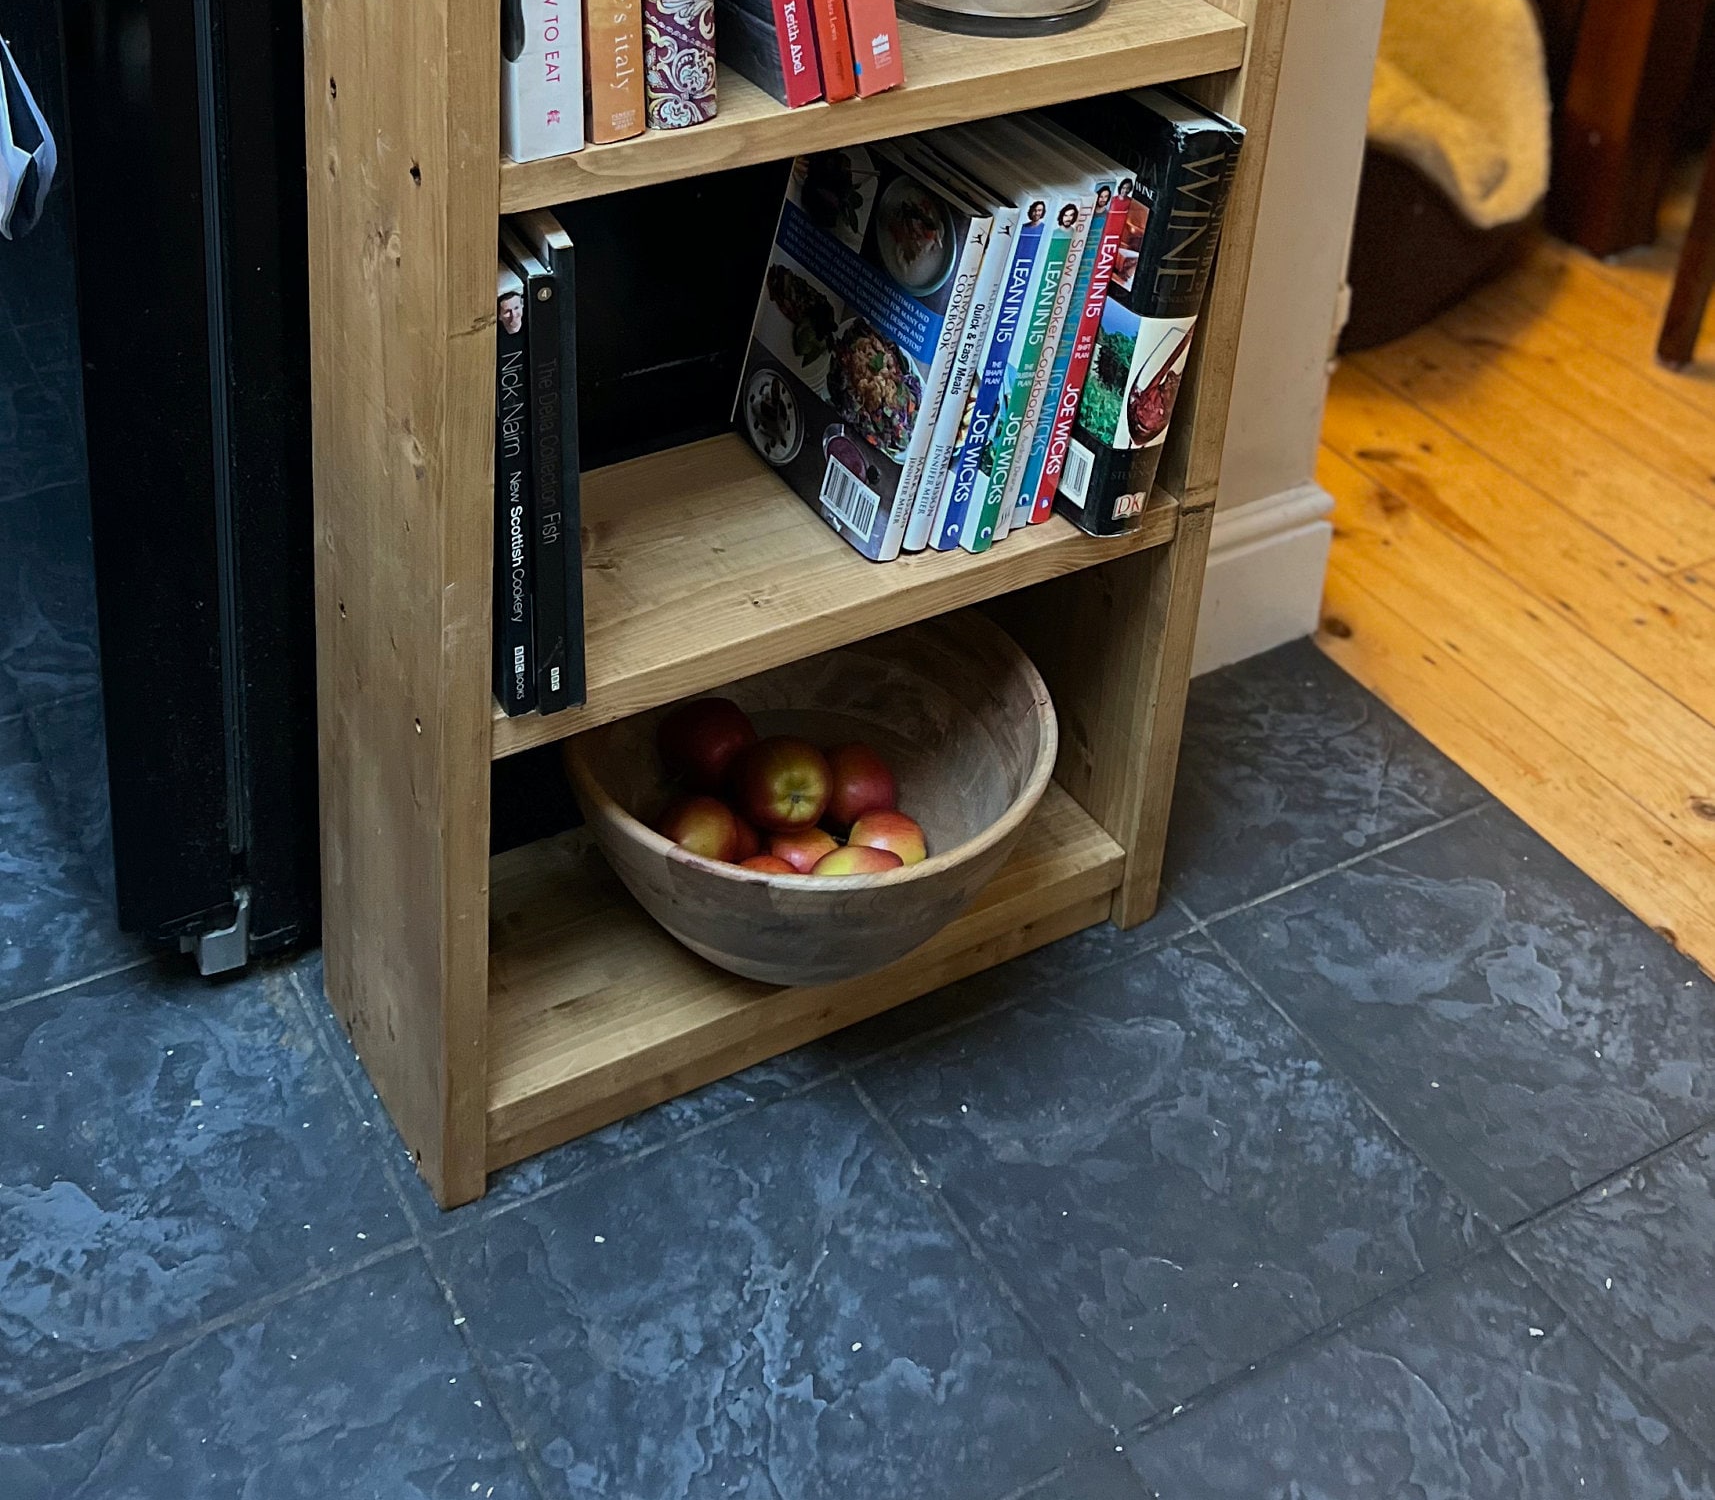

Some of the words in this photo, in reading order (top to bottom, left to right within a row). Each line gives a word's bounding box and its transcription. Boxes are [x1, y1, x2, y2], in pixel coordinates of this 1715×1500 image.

[543, 15, 560, 42] TO
[783, 0, 800, 42] Keith
[544, 50, 561, 83] EAT
[609, 32, 635, 92] italy
[790, 43, 805, 76] Abel
[1074, 204, 1093, 233] The
[1152, 150, 1226, 294] WINE
[1063, 239, 1084, 277] Slow
[1094, 234, 1120, 280] LEAN
[1007, 258, 1032, 304] LEAN
[1041, 261, 1063, 306] LEAN
[1090, 281, 1107, 300] IN
[900, 310, 918, 327] MANY
[917, 322, 927, 333] OF
[915, 309, 930, 323] AND
[938, 273, 969, 352] COOKBOOK
[969, 303, 986, 331] Quick
[999, 306, 1019, 325] IN
[1032, 308, 1050, 330] IN
[1046, 282, 1072, 341] Cooker
[1085, 302, 1103, 319] 15
[889, 312, 911, 333] DESIGN
[909, 328, 925, 344] AND
[966, 333, 974, 341] &
[996, 327, 1013, 343] 15
[1029, 331, 1044, 346] 15
[958, 342, 975, 365] Easy
[501, 350, 524, 401] Nick
[537, 357, 558, 390] The
[950, 367, 967, 396] Meals
[1047, 366, 1064, 399] JOE
[538, 392, 559, 434] Delia
[1060, 382, 1080, 418] JOE
[502, 402, 525, 459] Nairn
[968, 409, 991, 445] JOE
[1001, 411, 1022, 447] JOE
[1029, 402, 1054, 457] WICKS
[1046, 419, 1074, 476] WICKS
[539, 434, 560, 510] Collection
[925, 444, 944, 486] JENNIFER
[953, 449, 982, 504] WICKS
[987, 448, 1013, 505] WICKS
[509, 470, 522, 503] New
[917, 487, 931, 515] MEIER
[1118, 495, 1141, 515] DK
[510, 505, 525, 568] Scottish
[542, 511, 561, 545] Fish
[510, 568, 526, 623] Cookery
[514, 645, 525, 675] BBC
[550, 666, 560, 693] BBC
